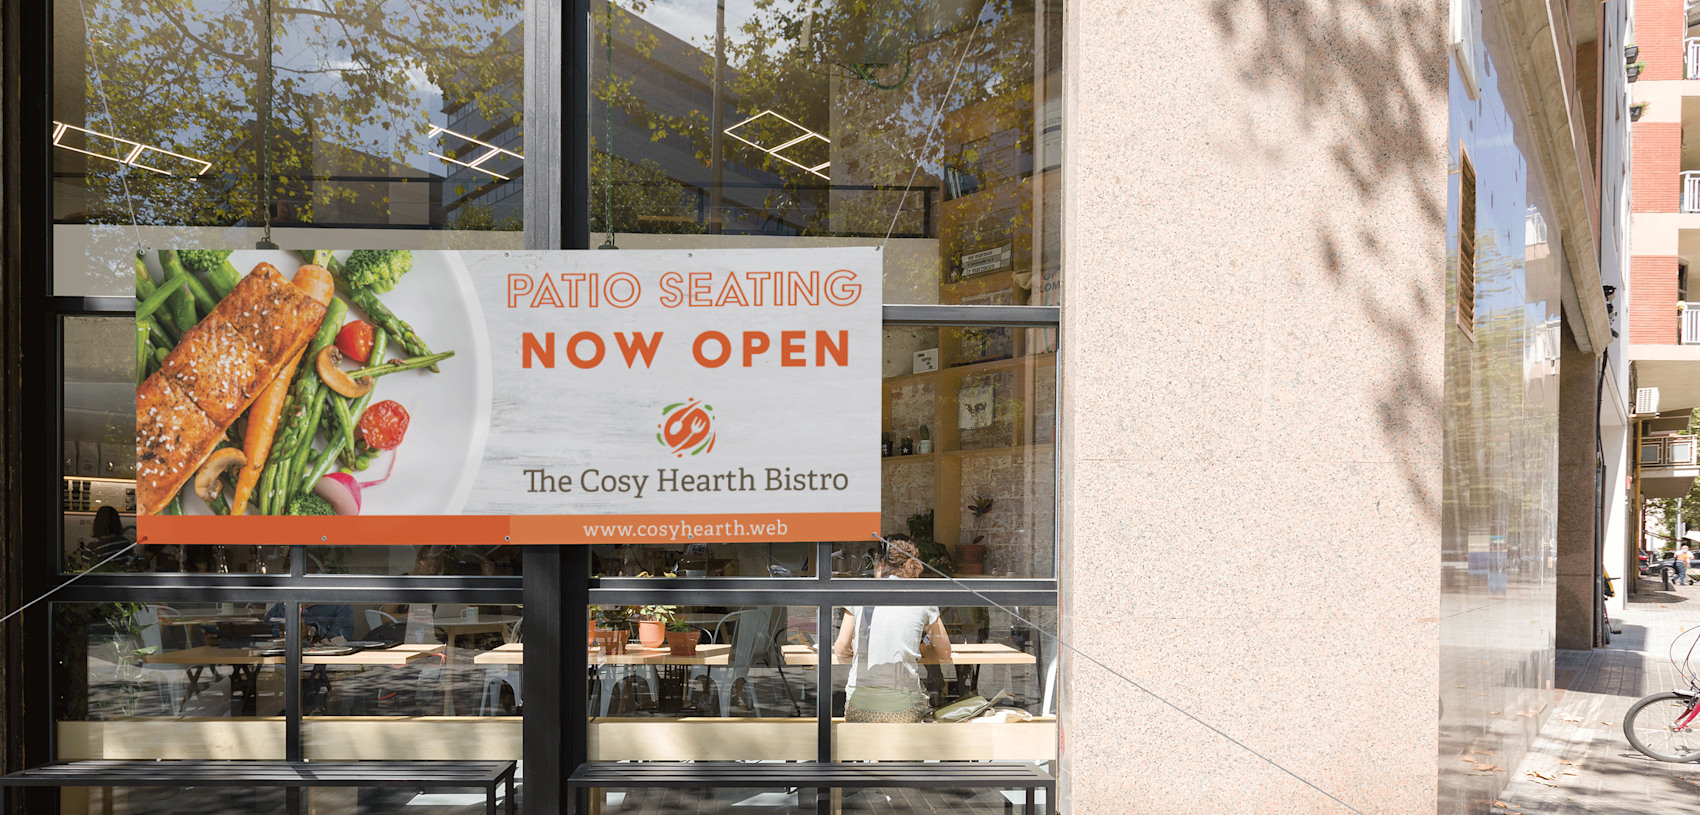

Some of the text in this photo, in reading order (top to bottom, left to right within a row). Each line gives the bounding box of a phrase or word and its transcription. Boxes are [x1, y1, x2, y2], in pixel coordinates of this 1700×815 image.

[508, 269, 862, 308] PATIO SEATING
[522, 330, 848, 369] NOW OPEN
[524, 468, 848, 498] The Cosy Hearth Bistro
[583, 519, 787, 538] www.cosyhearth.web
